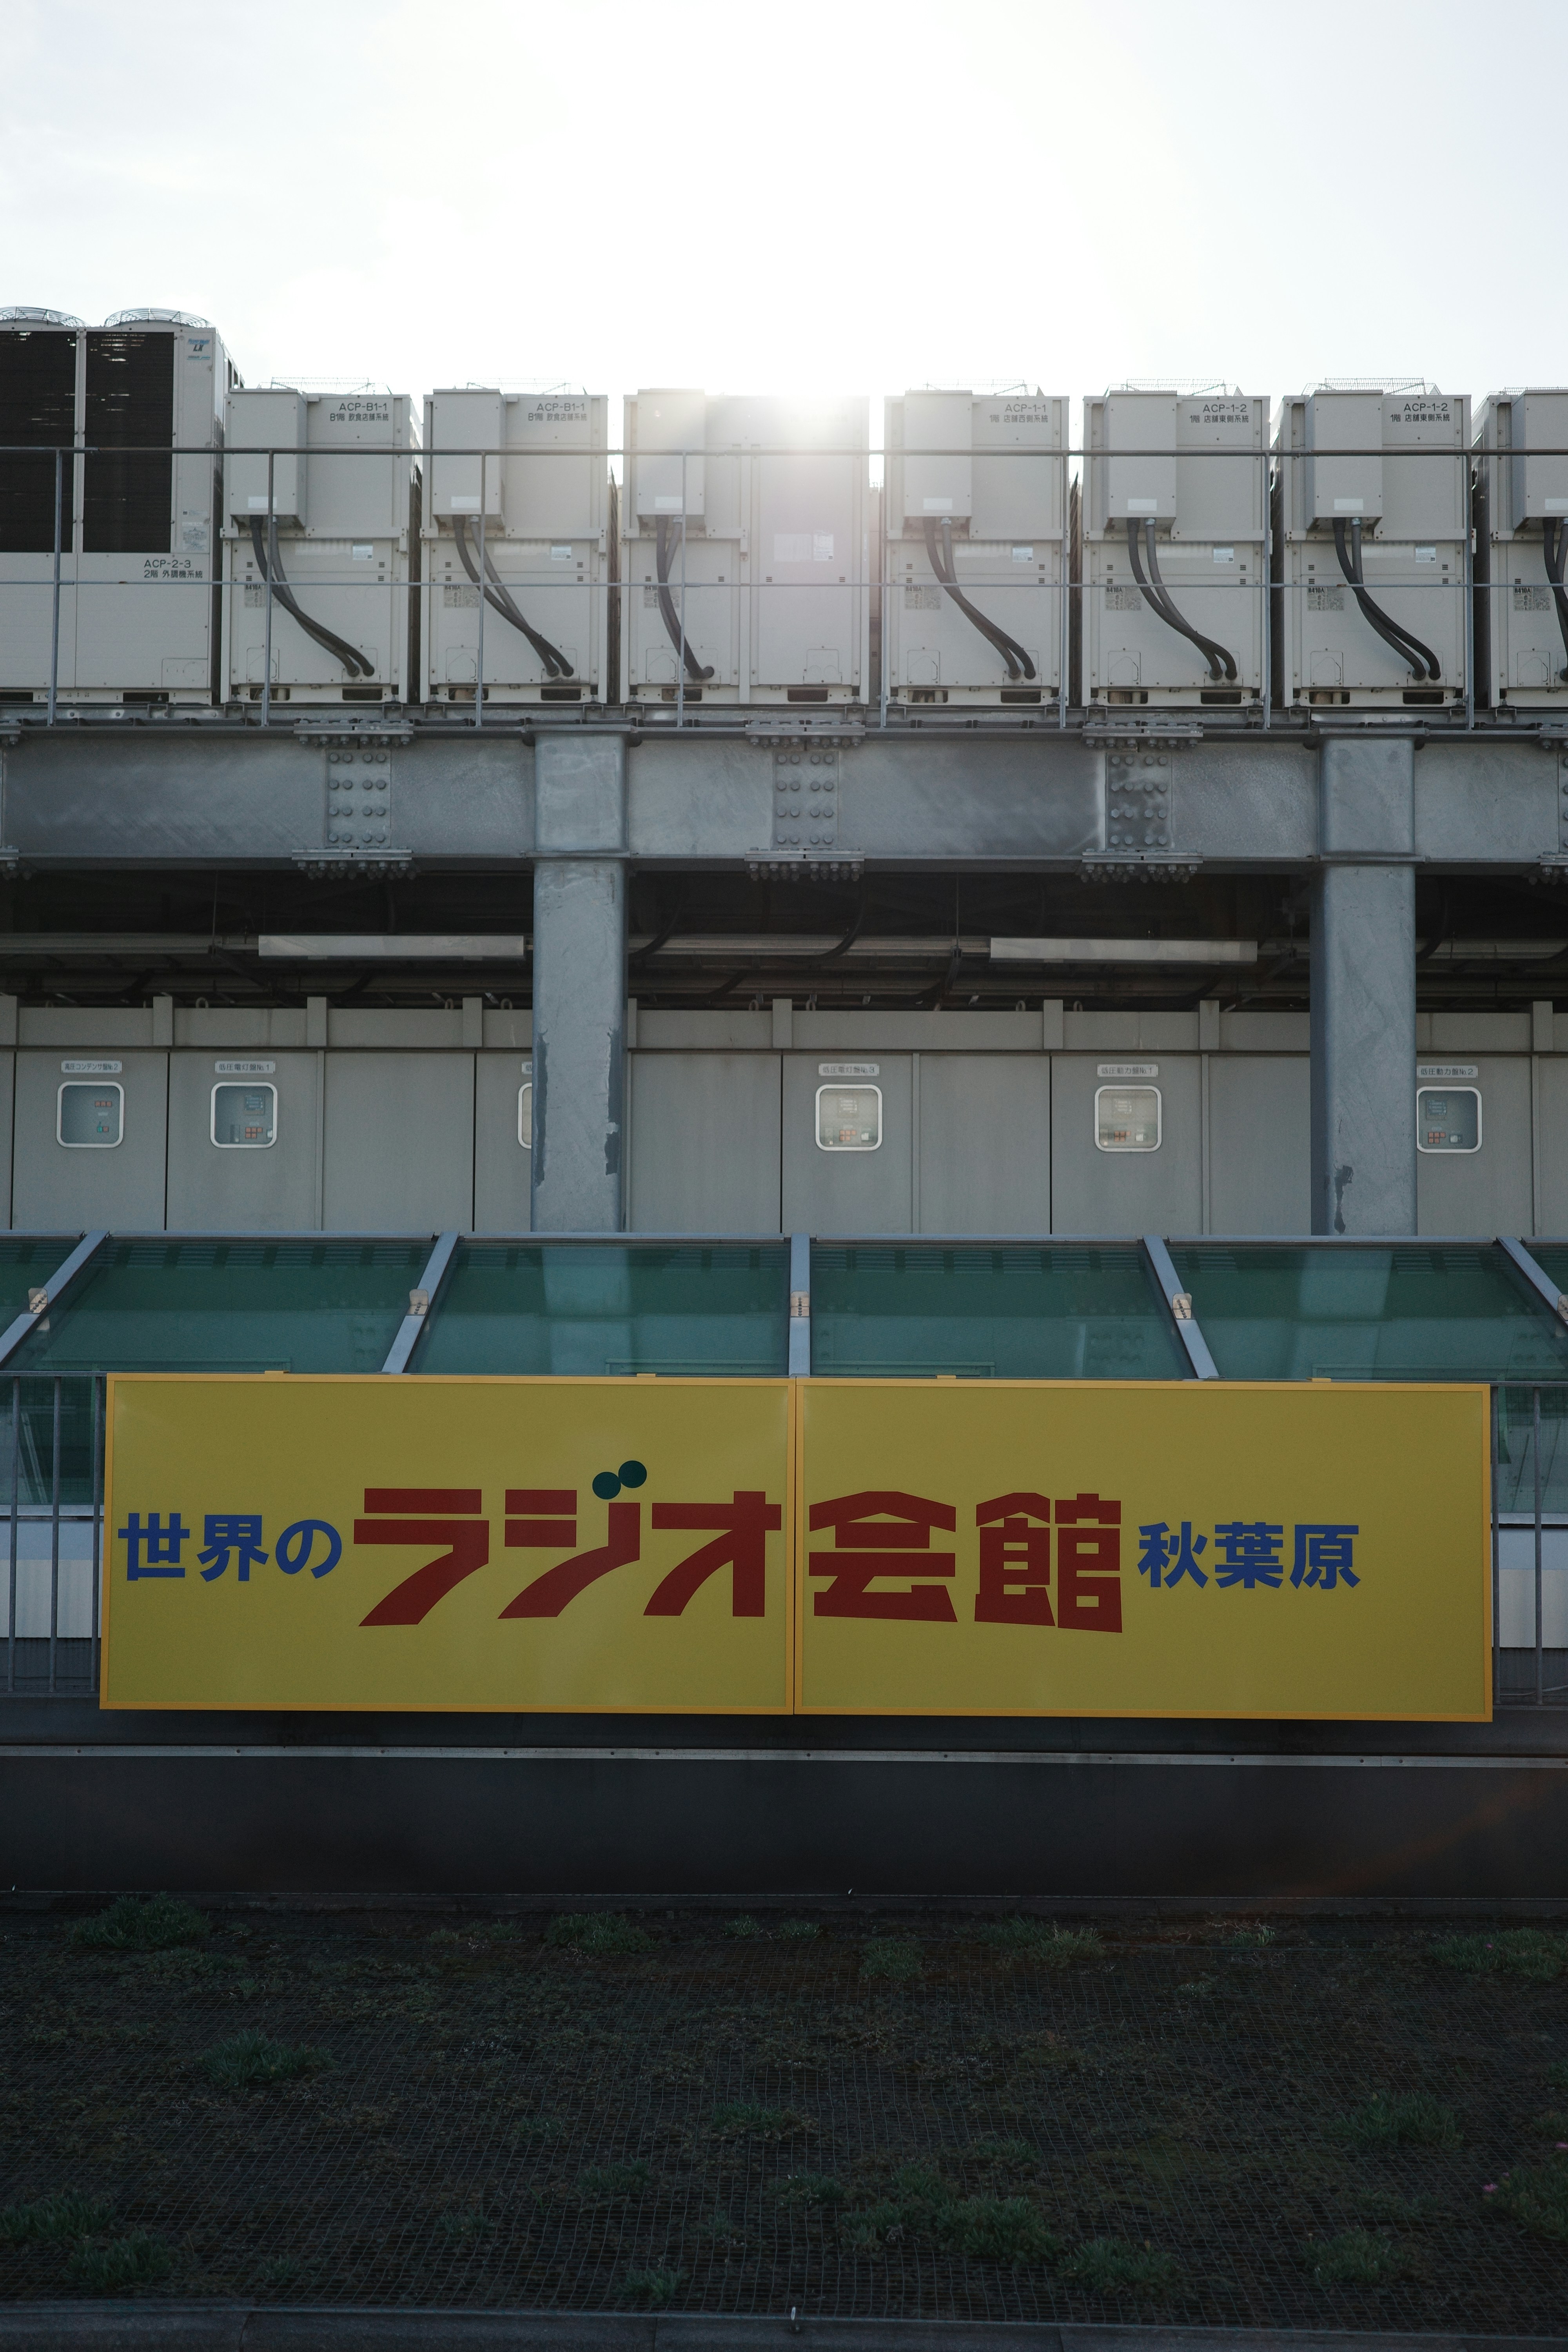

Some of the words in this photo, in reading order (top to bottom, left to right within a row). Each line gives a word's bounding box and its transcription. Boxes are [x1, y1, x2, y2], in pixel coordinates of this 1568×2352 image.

[339, 403, 387, 411] ACP-B1-1
[537, 403, 584, 411] ACP-B1-1
[1005, 404, 1046, 412] ACP-1-1
[1203, 404, 1247, 412] ACP-1-2
[1404, 403, 1448, 412] ACP-1-2
[528, 413, 543, 421] B1階
[1390, 414, 1401, 422] 1階
[144, 559, 191, 568] ACP-2-3
[144, 570, 158, 578] 2階
